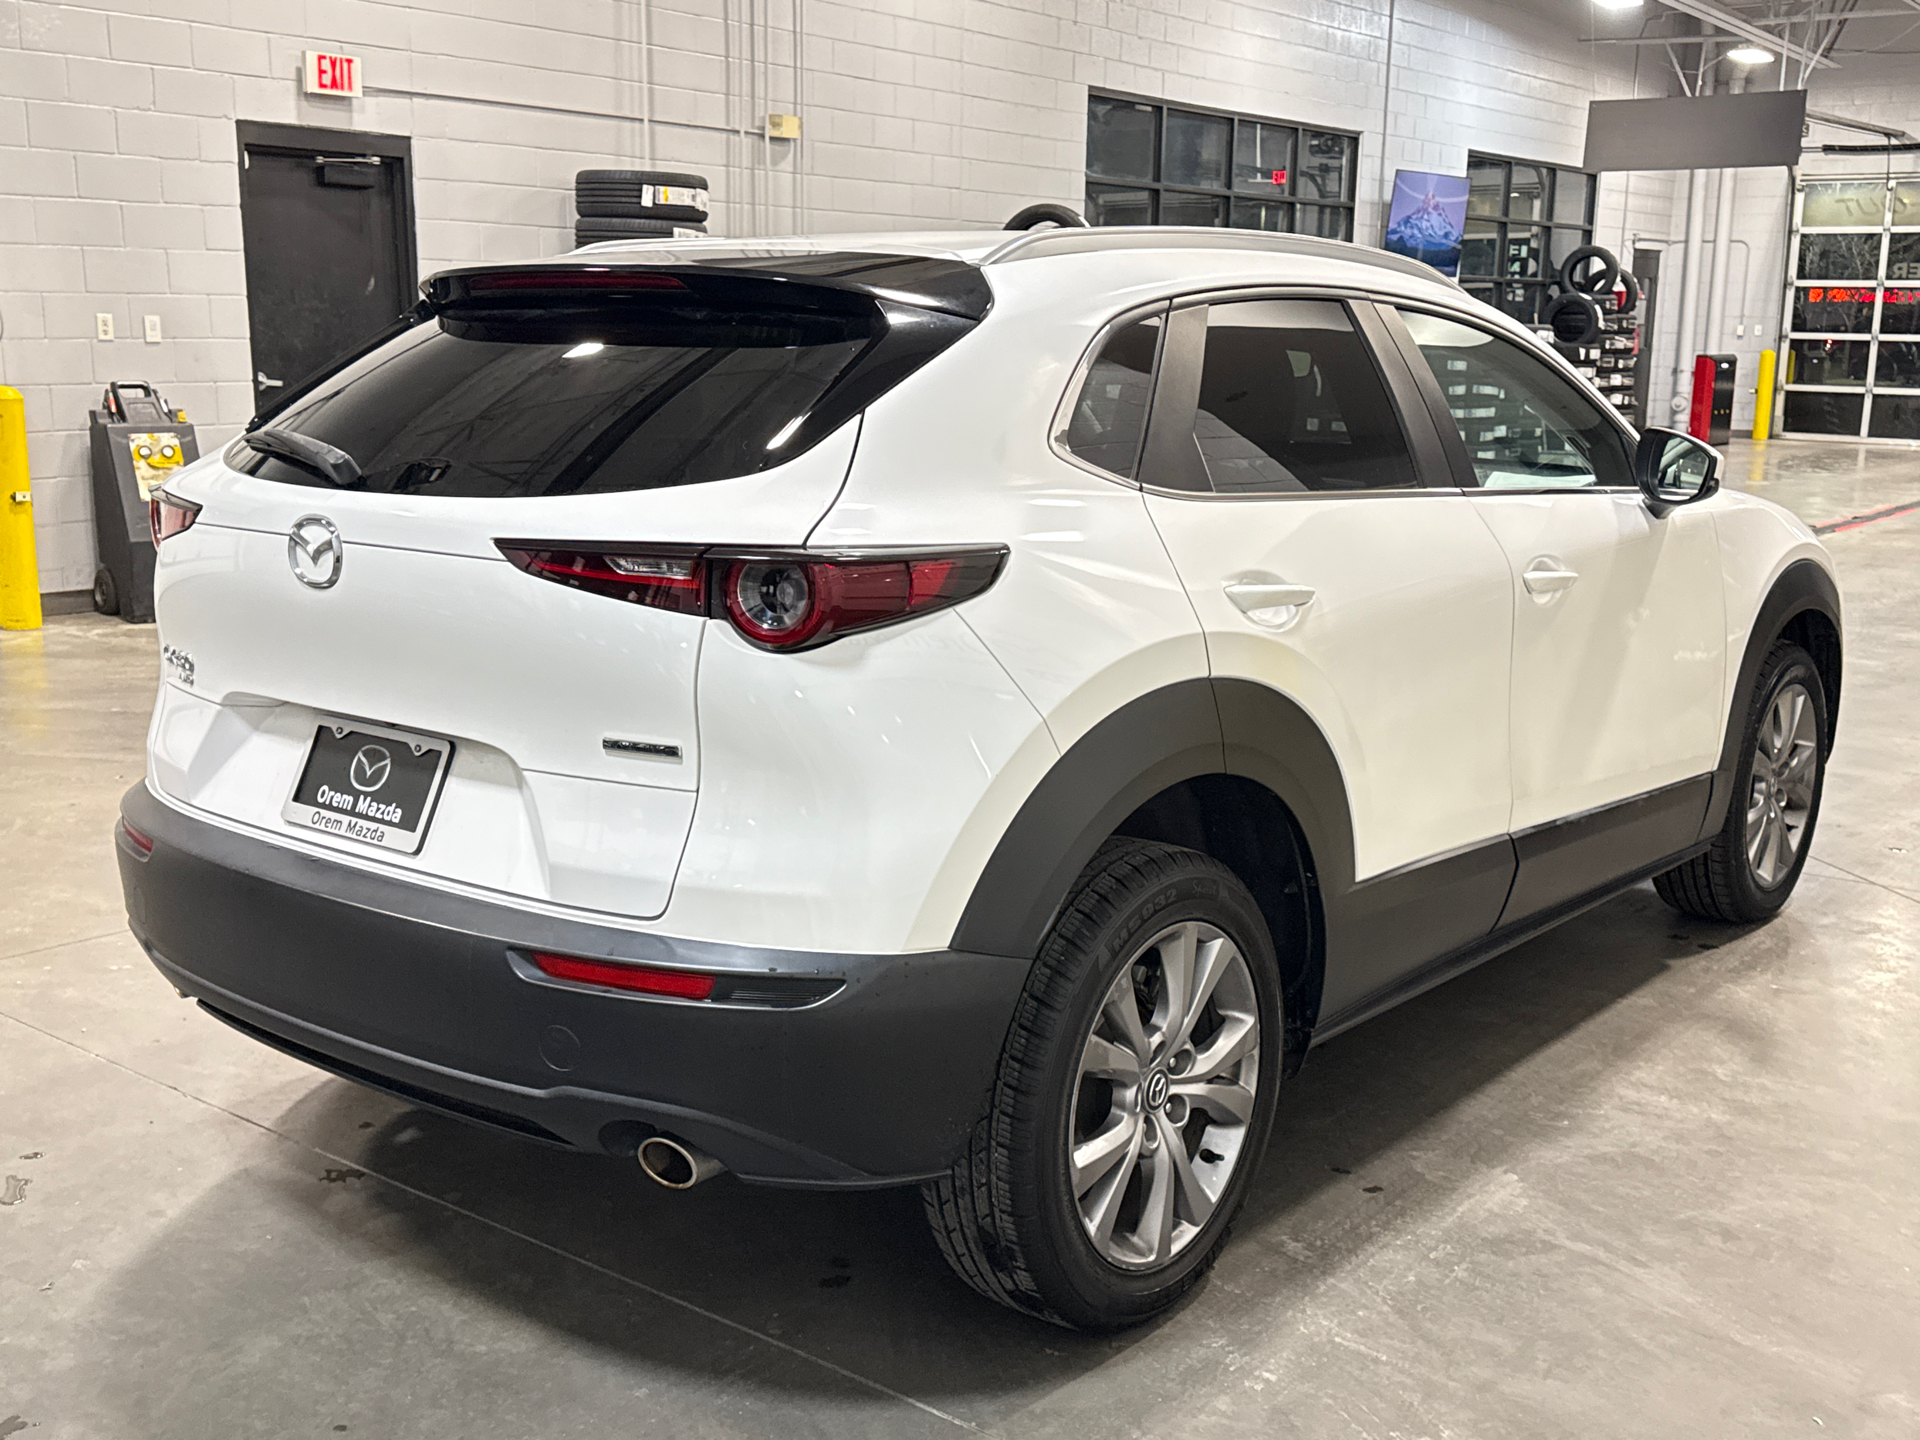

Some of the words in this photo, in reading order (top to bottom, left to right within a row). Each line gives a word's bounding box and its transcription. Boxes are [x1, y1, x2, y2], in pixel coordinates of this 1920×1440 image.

[317, 54, 354, 92] EXIT
[316, 784, 353, 811] Orem
[355, 794, 402, 823] Mazda
[311, 811, 343, 831] Orem
[345, 819, 385, 843] Mazda
